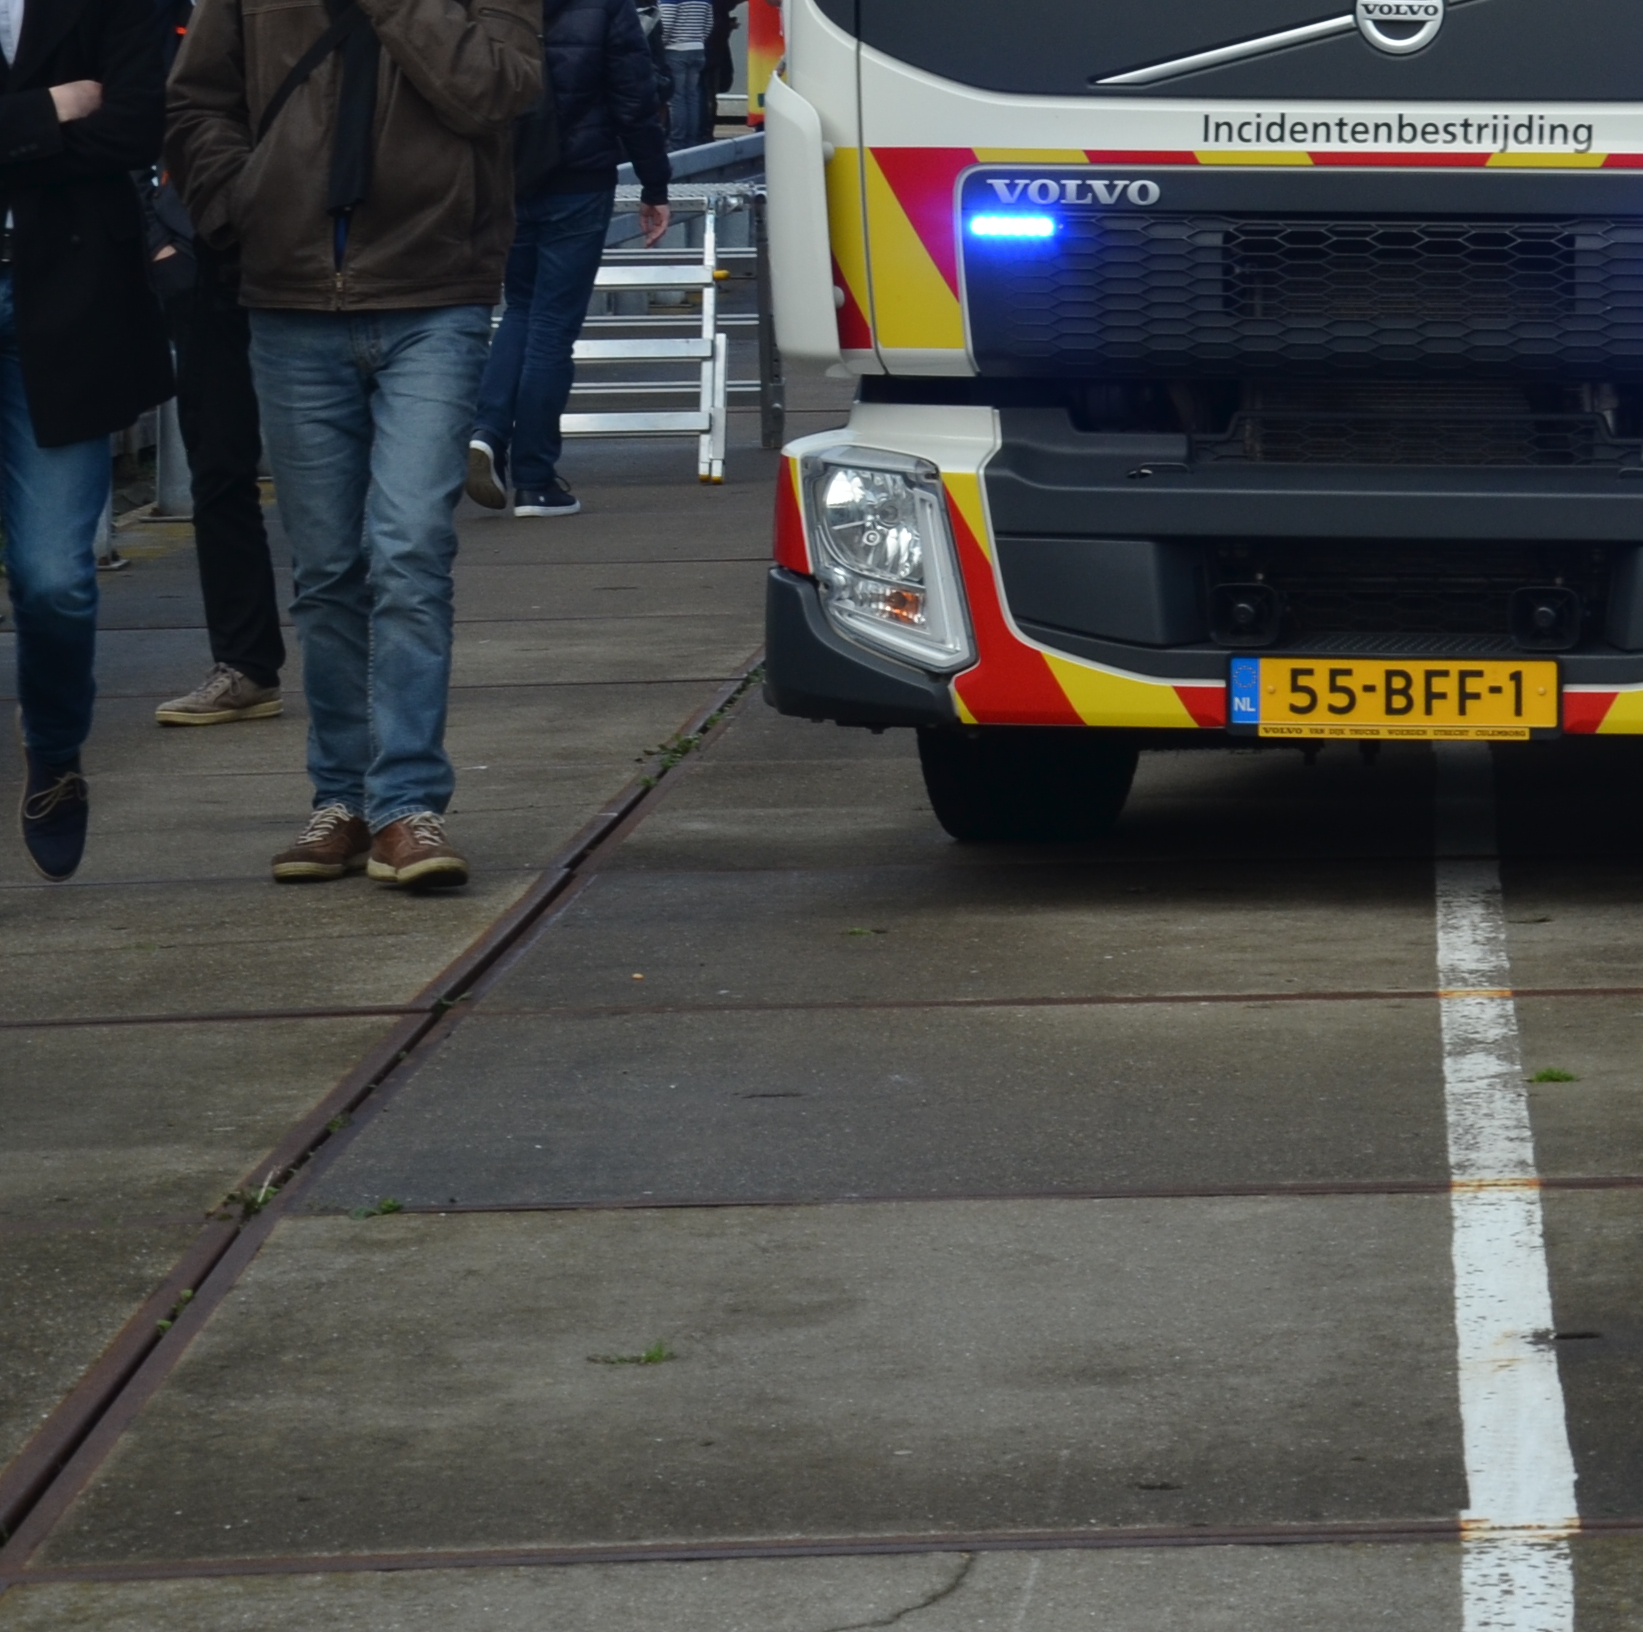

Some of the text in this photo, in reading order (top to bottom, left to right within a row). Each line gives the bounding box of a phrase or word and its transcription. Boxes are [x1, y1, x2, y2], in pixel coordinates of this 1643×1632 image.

[1360, 3, 1439, 16] VOLVO
[1202, 113, 1594, 153] Incidentenbestrijding
[985, 178, 1161, 205] VOLVO
[1288, 667, 1524, 717] 55-BFF-1
[1233, 696, 1256, 713] NL
[1262, 726, 1303, 736] VOLVO
